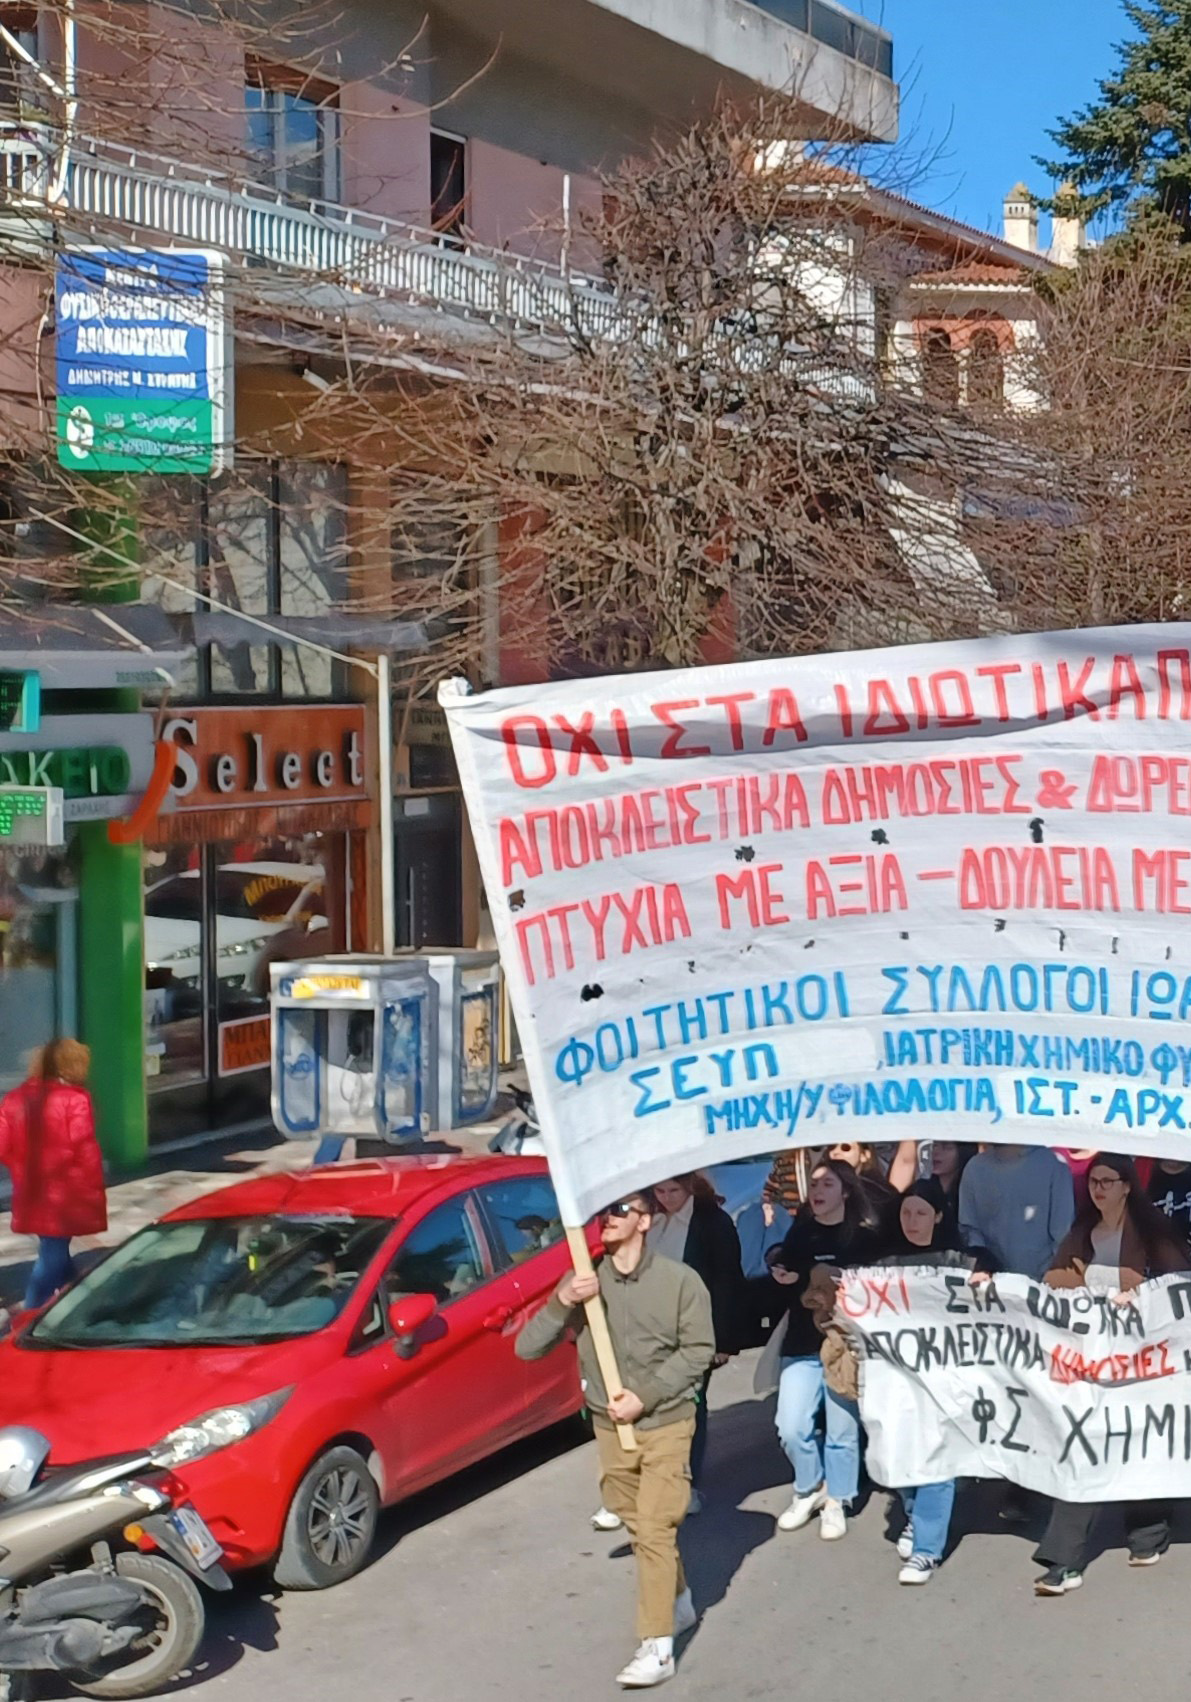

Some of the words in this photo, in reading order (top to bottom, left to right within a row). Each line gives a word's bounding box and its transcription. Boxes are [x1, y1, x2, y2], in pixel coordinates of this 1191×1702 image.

[162, 718, 363, 797] Select
[500, 708, 633, 789] ΟΧΙ
[650, 688, 808, 759] ΣΤΑ
[833, 652, 1147, 738] ΙΔΙΩΤΙΚΑ
[498, 772, 810, 888] ΑΠΟΚΛΕΙΣΤΙΚΑ
[822, 754, 1033, 825] ΔΗΜΟΣΙΕΣ
[1036, 769, 1079, 810] &
[515, 883, 691, 986] ΠΤΥΧΙΑ
[715, 863, 790, 929] ΜΕ
[806, 853, 909, 920] ΑΞΙΑ
[959, 846, 1120, 912] ΔΟΥΛΕΙΑ
[555, 970, 850, 1086] ΦΟΙΤΗΤΙΚΟΙ
[881, 963, 1109, 1015] ΣΥΛΛΟΓΟΙ
[630, 1042, 779, 1118] ΣΕΥΠ
[841, 1272, 911, 1317] ΟΧΙ
[945, 1275, 1006, 1314] ΣΤΑ
[862, 1322, 1046, 1373] ΑΠΟΚΛΕΙΣΤΙΚΑ
